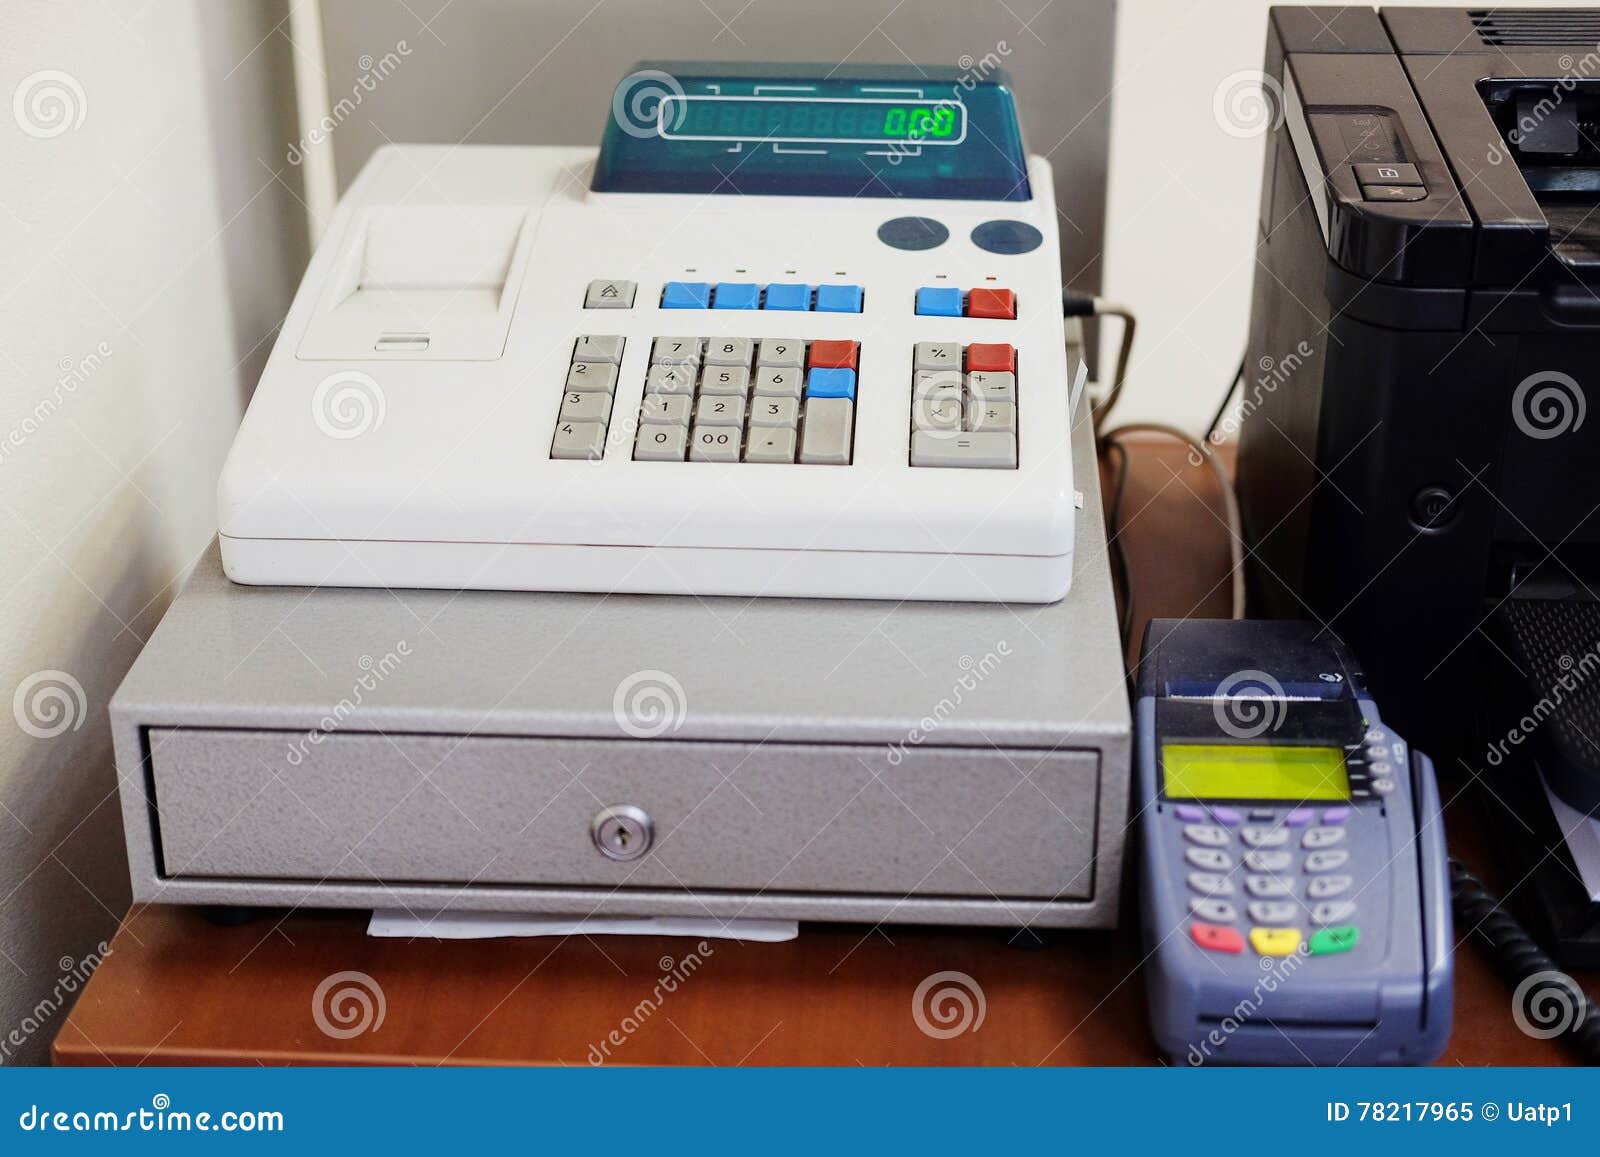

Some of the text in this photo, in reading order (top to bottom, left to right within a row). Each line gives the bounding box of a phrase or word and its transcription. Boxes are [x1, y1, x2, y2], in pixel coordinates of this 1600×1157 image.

[672, 343, 682, 352] 7
[722, 344, 734, 353] 8
[775, 345, 787, 355] 9
[575, 364, 587, 374] 2
[665, 371, 675, 381] 4
[719, 372, 730, 382] 5
[772, 374, 784, 384] 6
[570, 393, 581, 404] 3
[714, 403, 725, 412] 2
[768, 404, 779, 414] 3
[562, 424, 573, 435] 4
